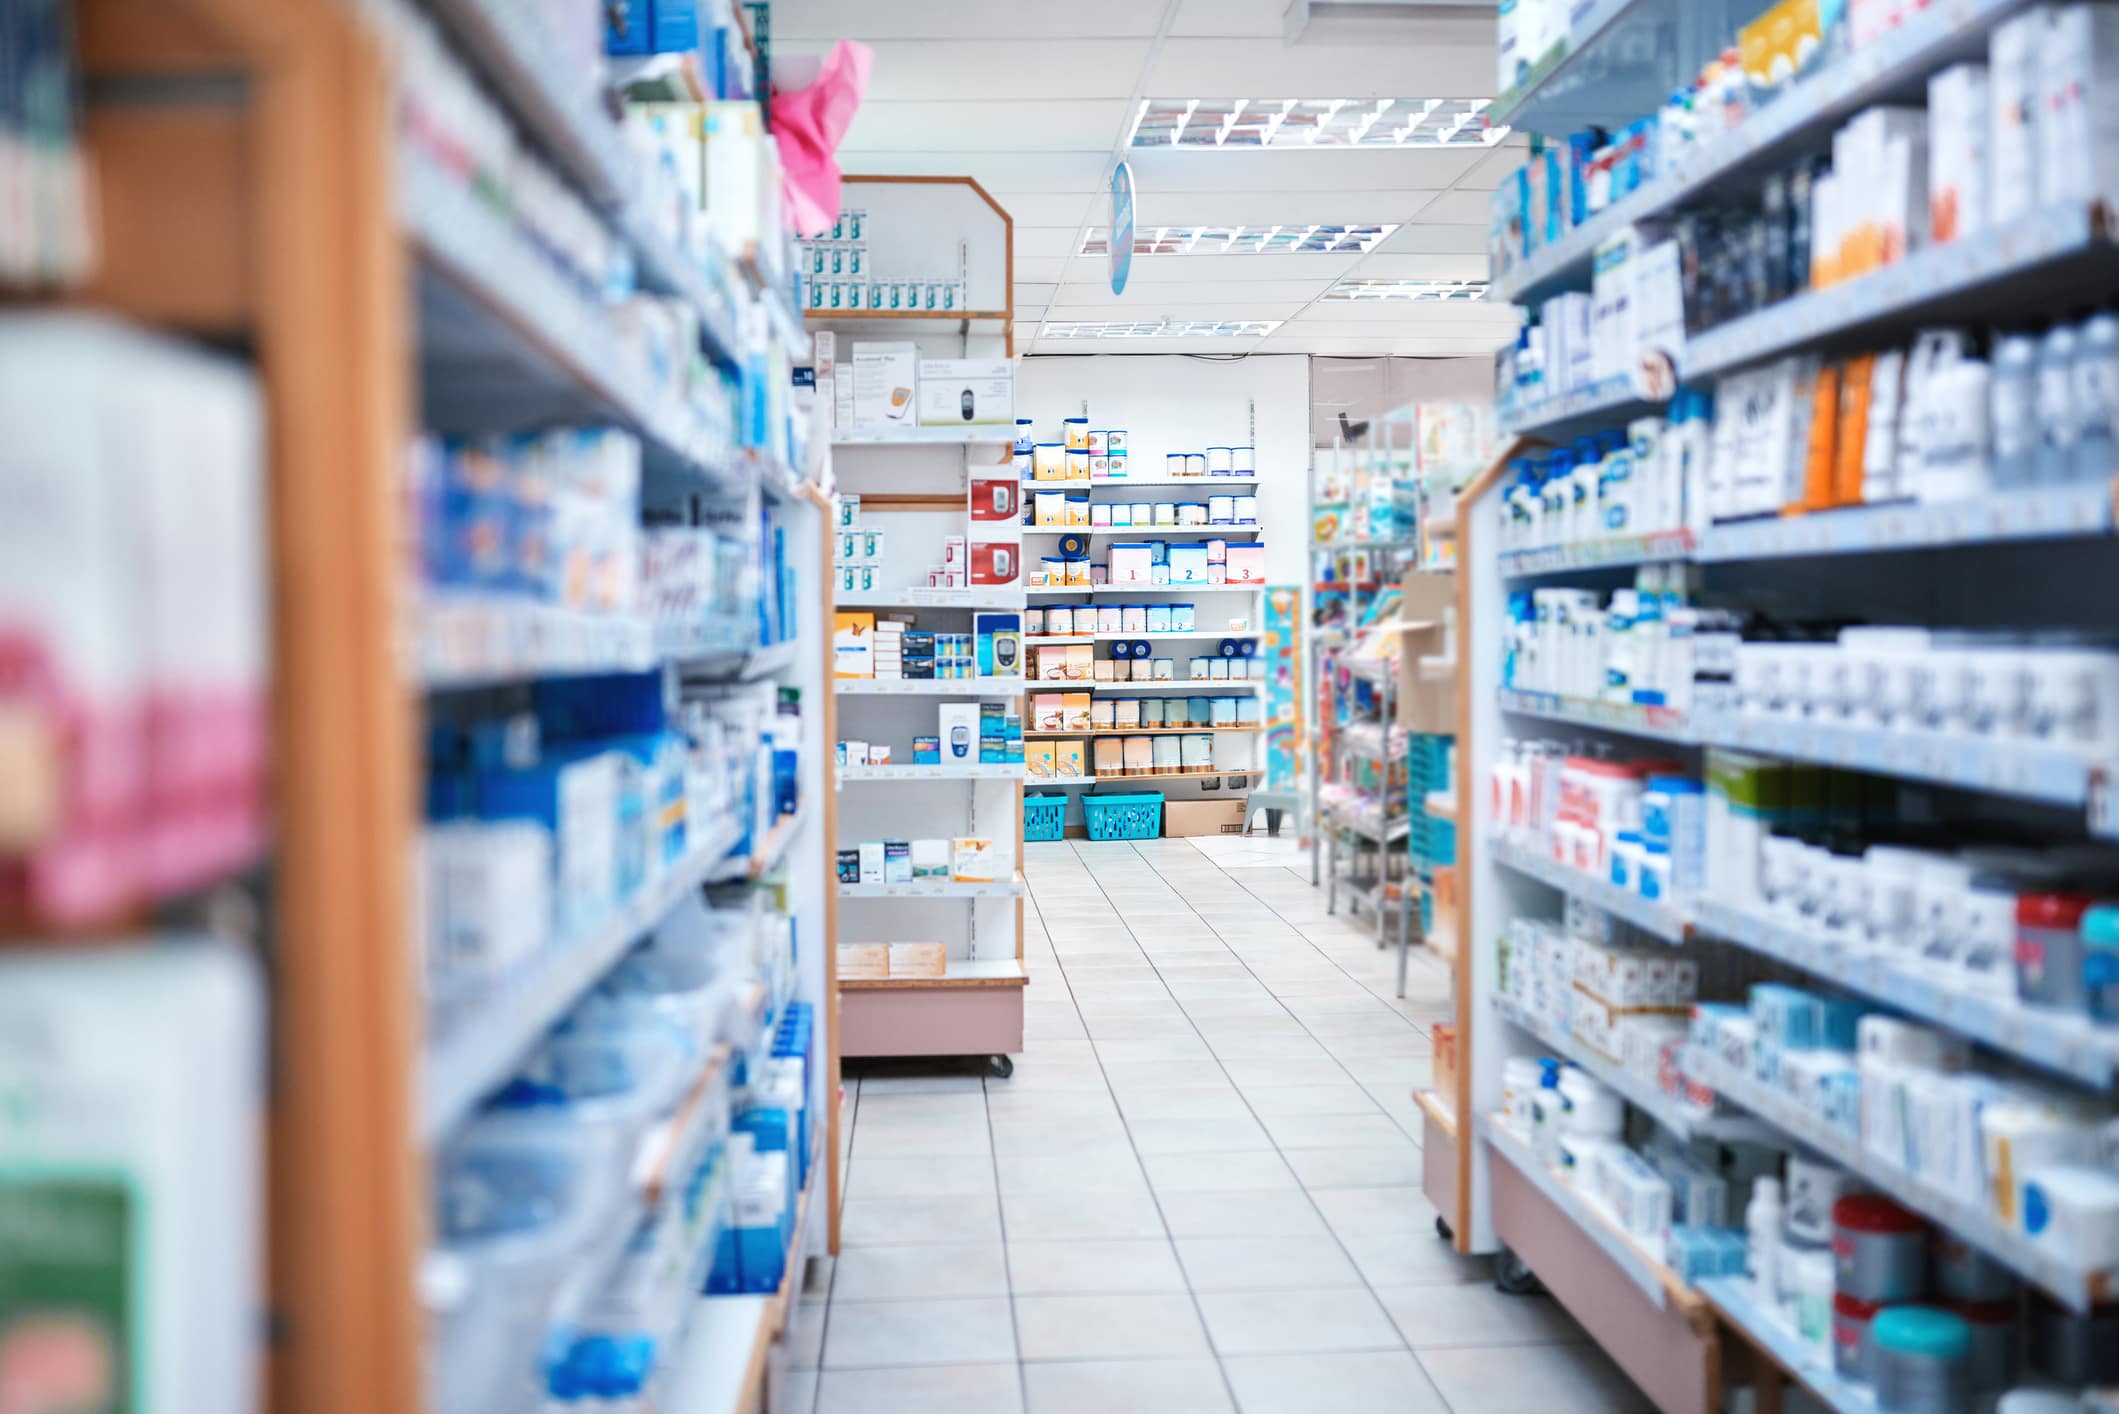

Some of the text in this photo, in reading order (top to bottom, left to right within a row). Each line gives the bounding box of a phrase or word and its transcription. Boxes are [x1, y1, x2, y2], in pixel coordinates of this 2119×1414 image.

[1130, 569, 1136, 580] 1
[1185, 569, 1193, 580] 2
[1242, 569, 1249, 579] 3
